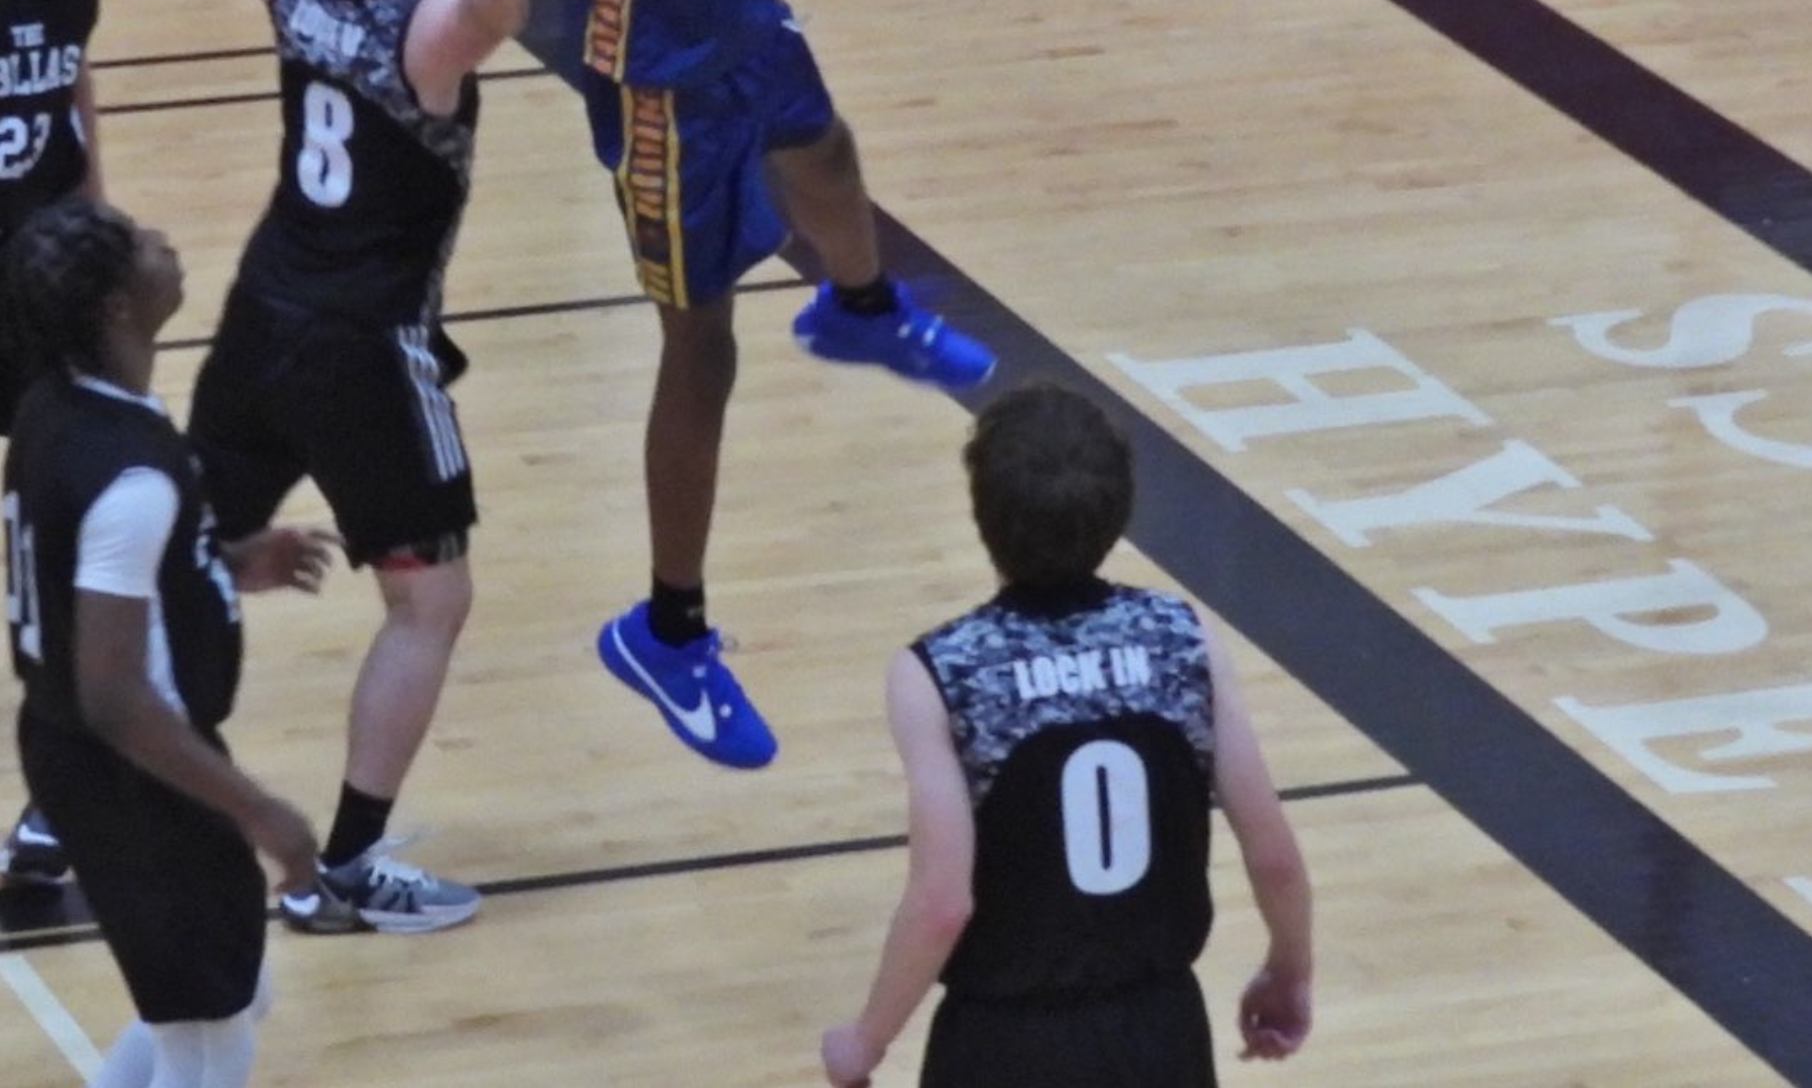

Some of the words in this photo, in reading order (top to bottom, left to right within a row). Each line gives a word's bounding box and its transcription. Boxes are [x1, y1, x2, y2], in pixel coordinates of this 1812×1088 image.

[298, 80, 355, 209] 8
[1013, 649, 1107, 700] LOCK
[1109, 644, 1151, 687] IN
[1105, 327, 1812, 904] HYPE
[1061, 739, 1151, 896] 0
